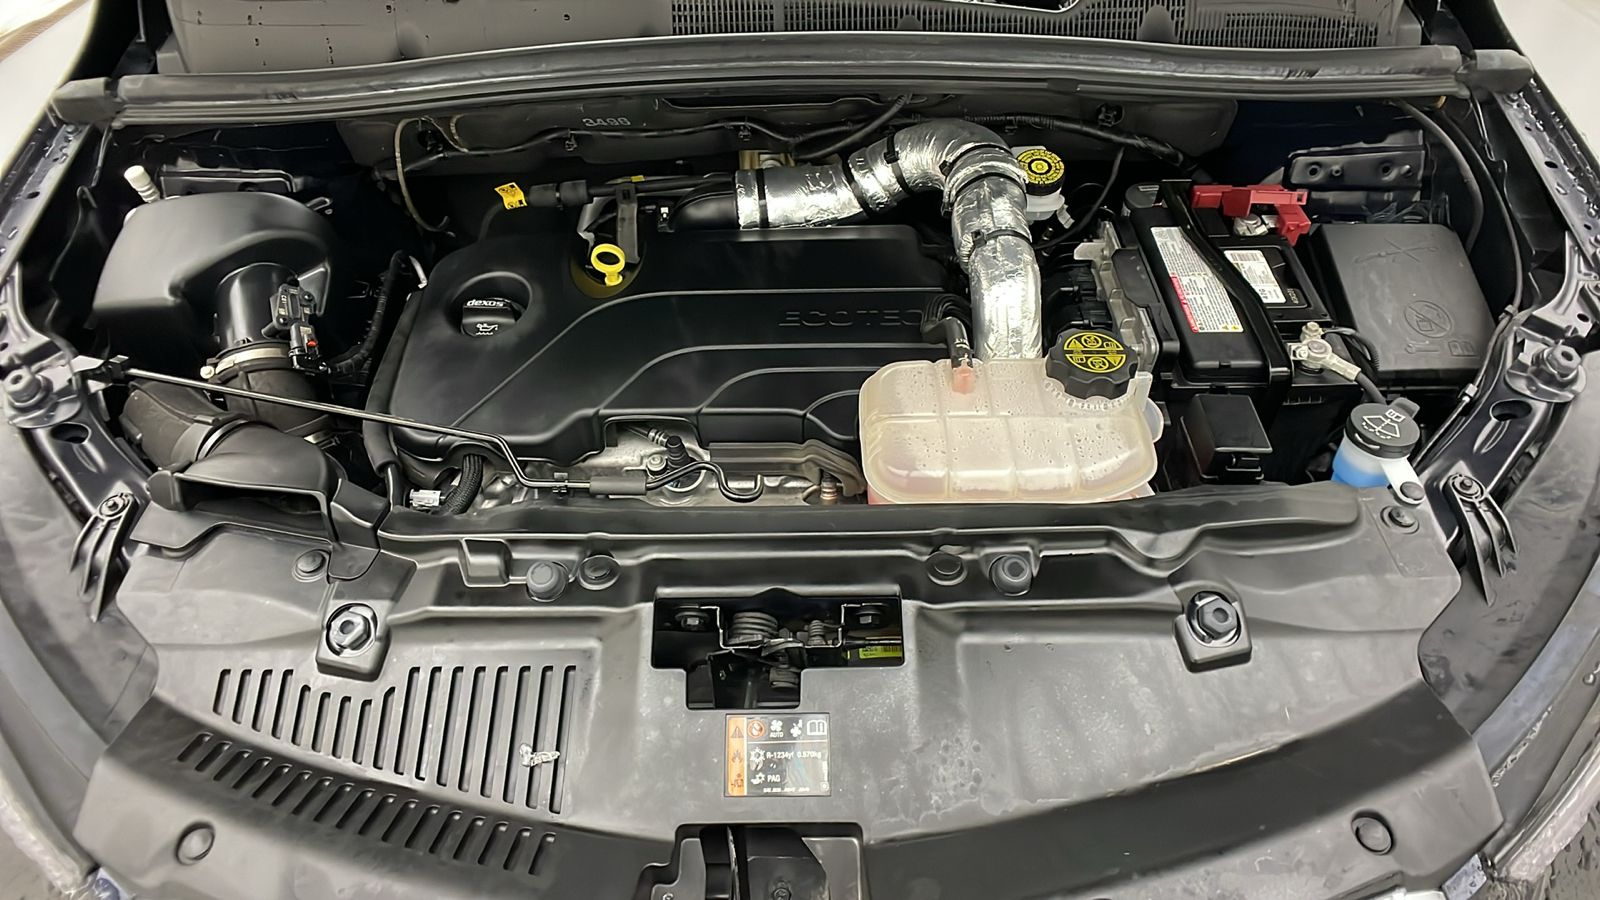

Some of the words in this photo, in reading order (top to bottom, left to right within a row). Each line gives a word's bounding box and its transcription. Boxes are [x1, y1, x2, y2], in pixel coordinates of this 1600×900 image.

[466, 299, 505, 307] dexos
[779, 309, 922, 326] ECOTEC
[766, 774, 781, 783] PAG
